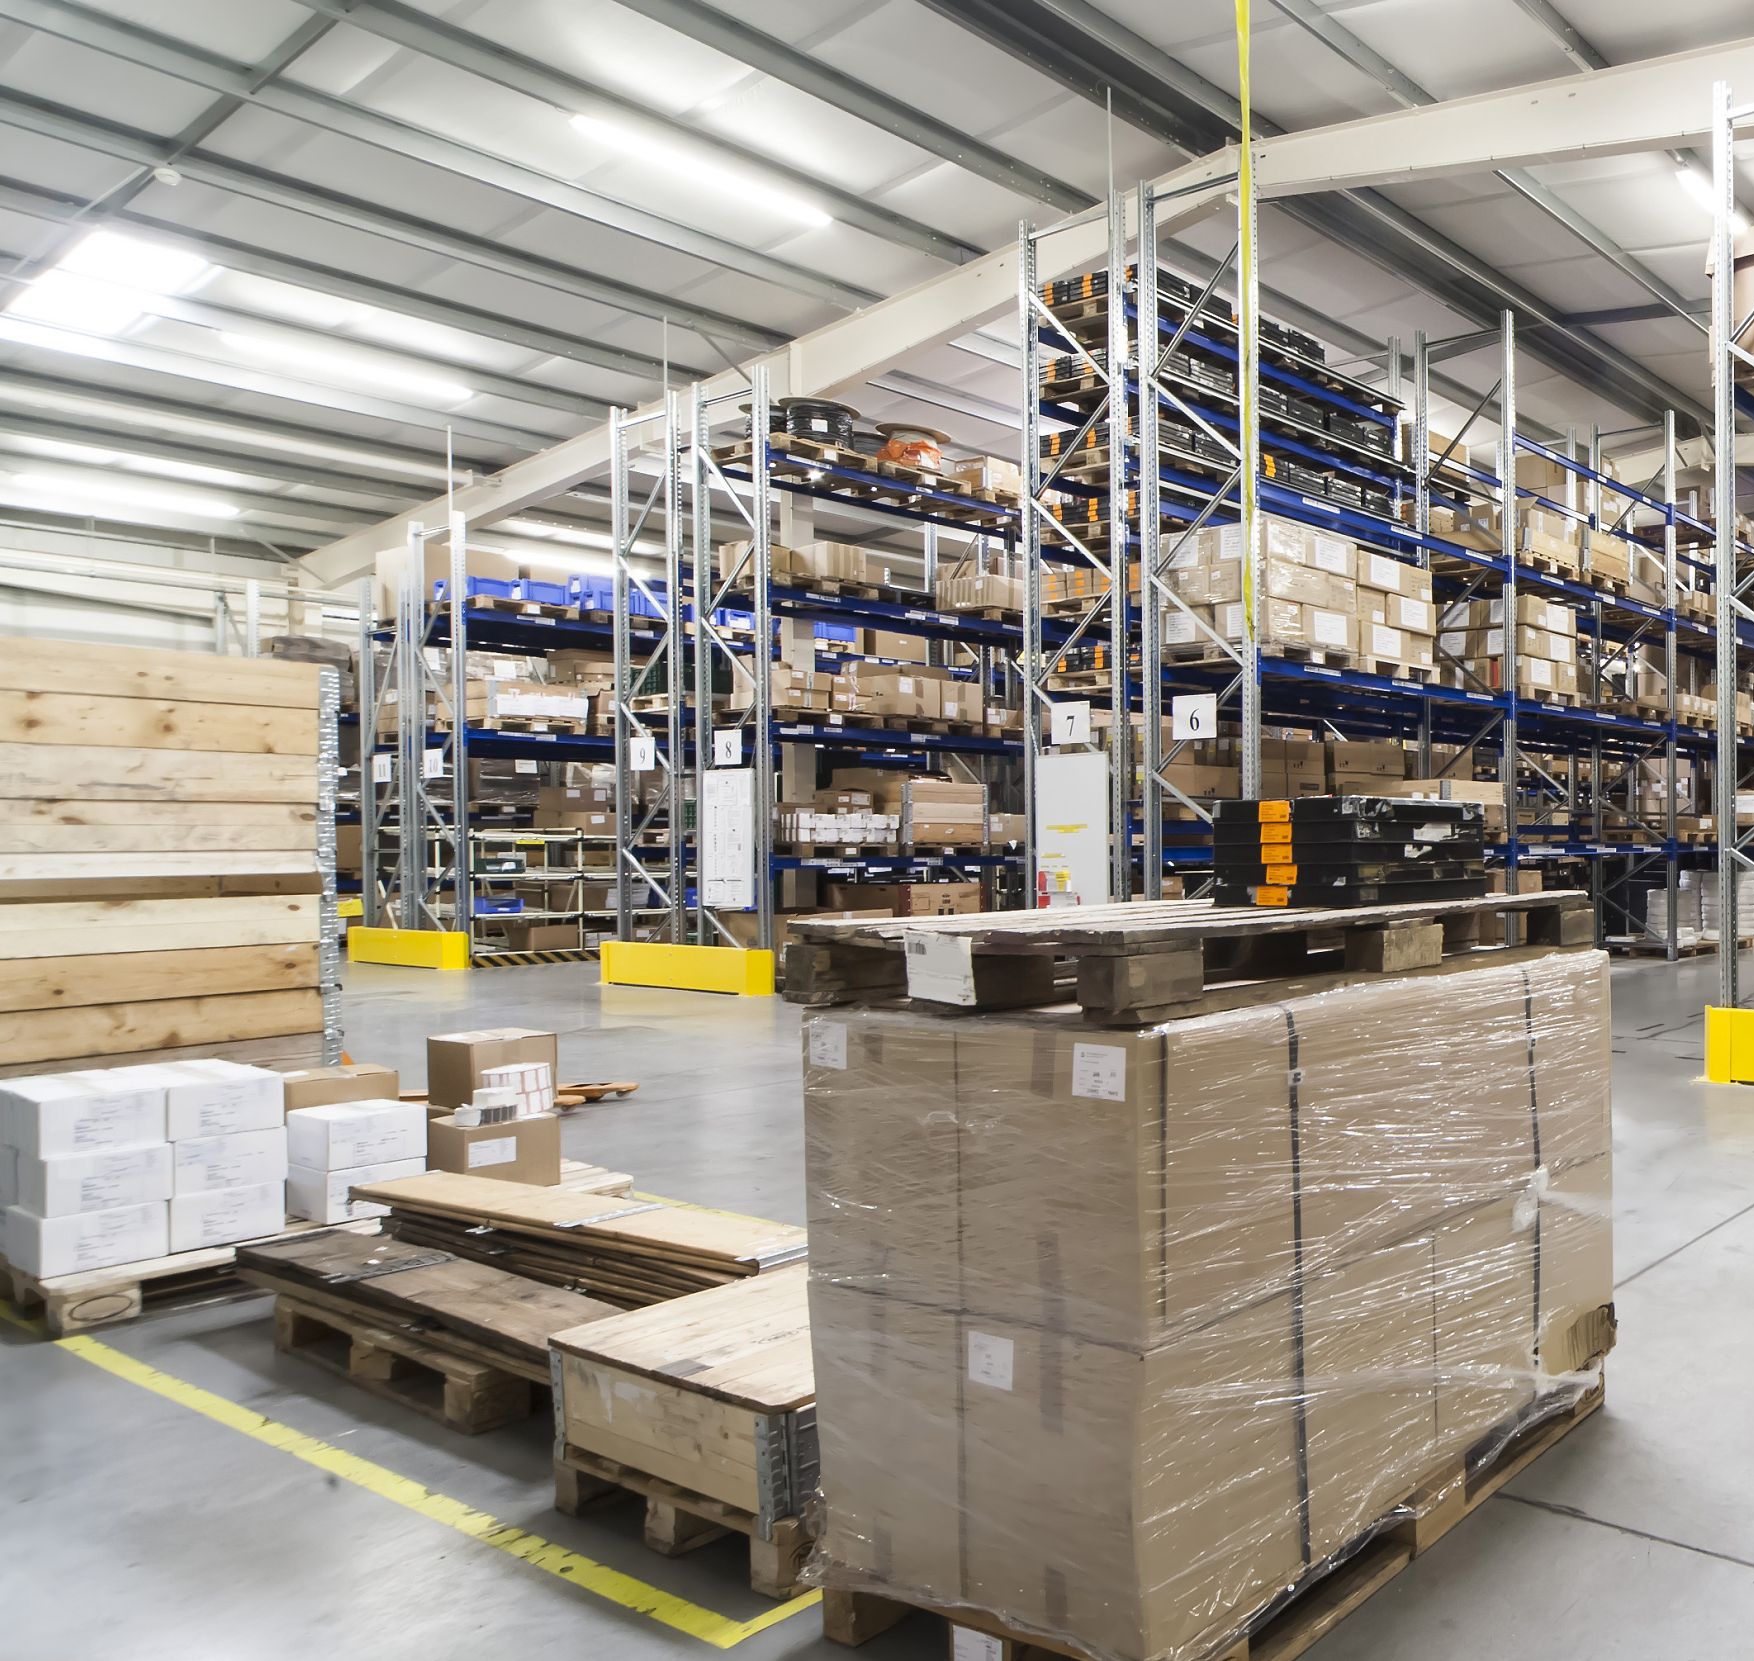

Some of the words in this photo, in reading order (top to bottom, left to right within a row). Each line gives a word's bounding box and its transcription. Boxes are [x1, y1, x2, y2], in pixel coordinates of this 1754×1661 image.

[1066, 715, 1075, 737] 7
[1189, 707, 1200, 732] 6
[639, 746, 646, 765] 9
[725, 740, 732, 759] 8
[378, 762, 387, 778] 11
[429, 757, 439, 773] 10
